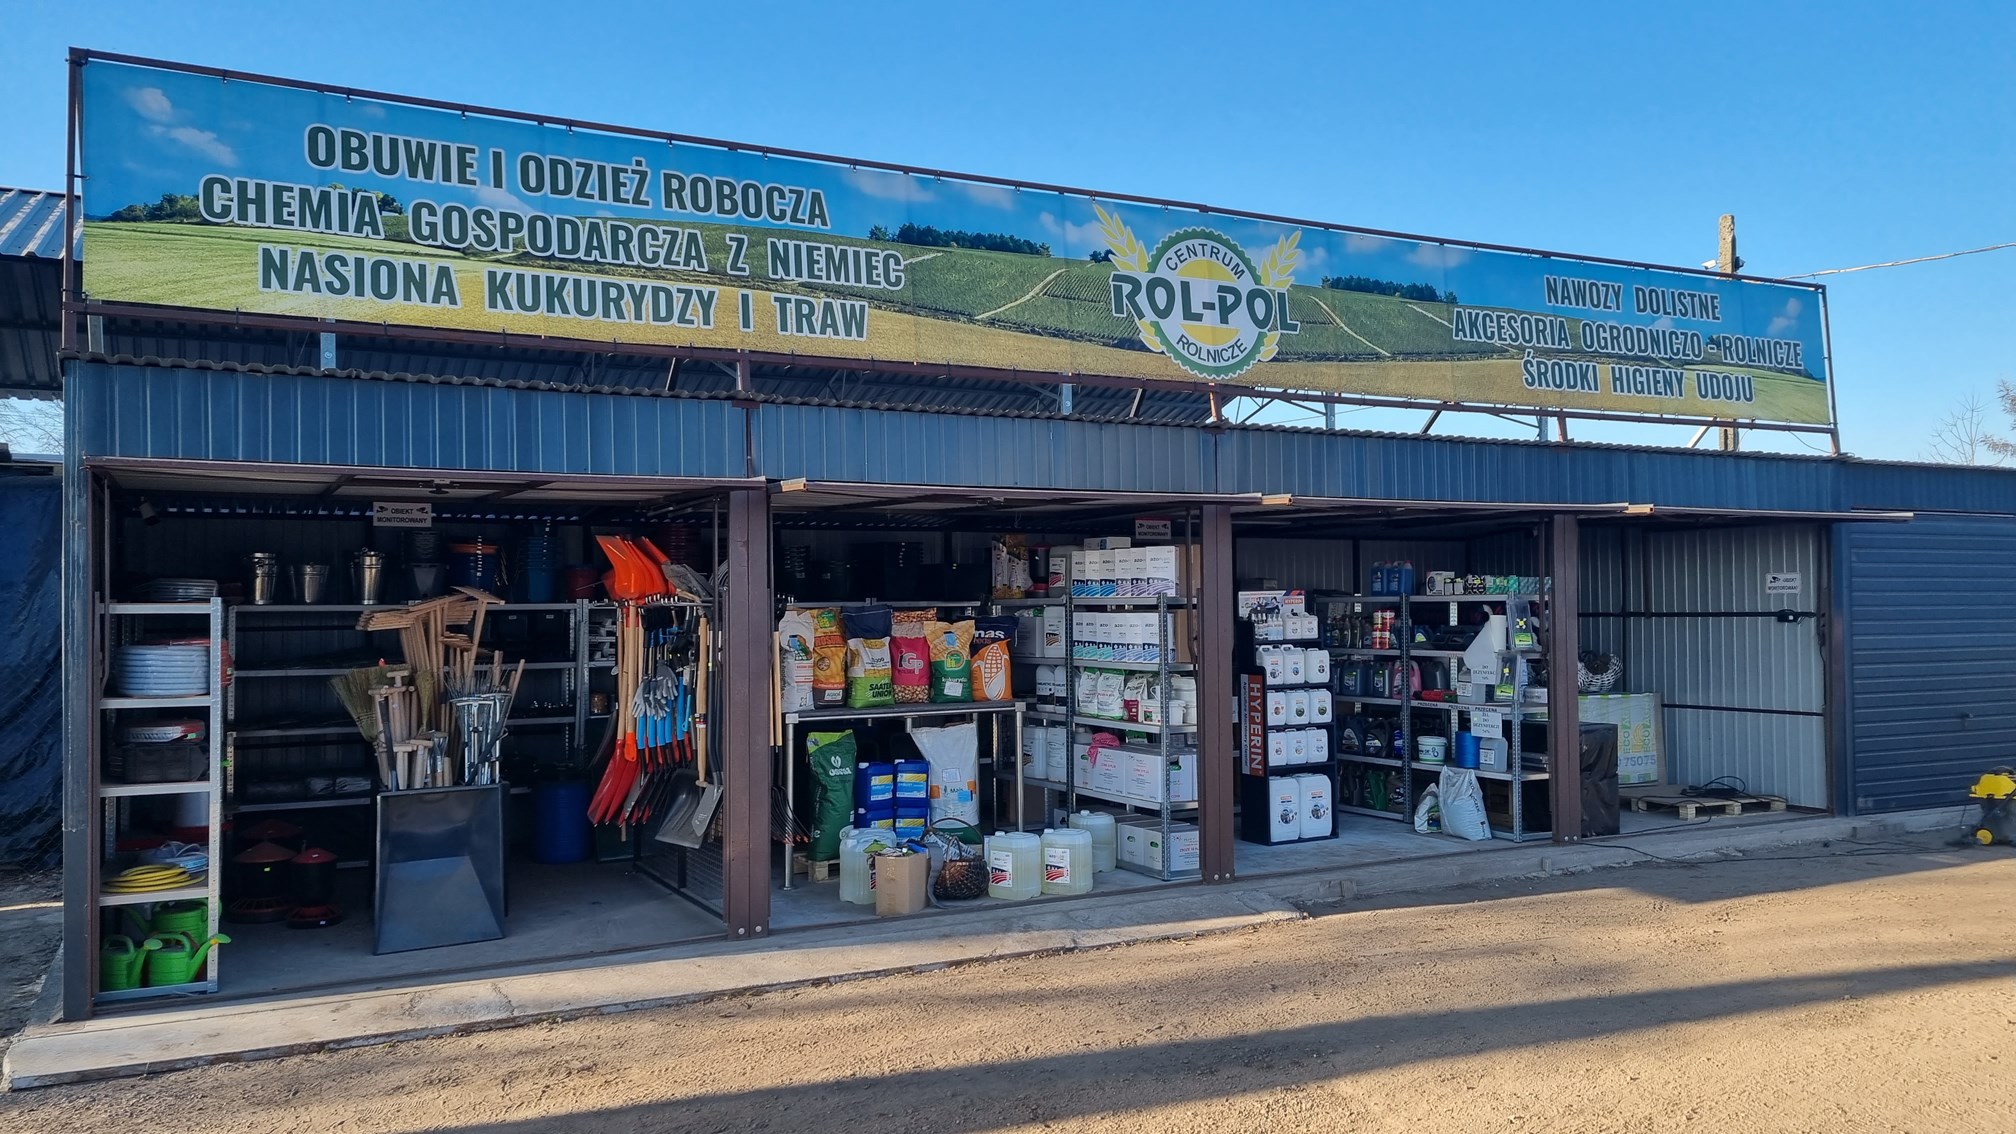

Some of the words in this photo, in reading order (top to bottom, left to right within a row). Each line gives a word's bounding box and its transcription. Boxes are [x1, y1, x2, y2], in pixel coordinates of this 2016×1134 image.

[306, 125, 478, 187] OBUWIE
[491, 149, 504, 190] I
[519, 153, 651, 207] ODZIEŻ
[662, 171, 830, 228] ROBOCZA
[201, 176, 383, 238] CHEMIA
[410, 200, 707, 270] GOSPODARCZA
[727, 235, 748, 274] Z
[769, 239, 904, 289] NIEMIEC
[1165, 243, 1246, 280] CENTRUM
[261, 246, 459, 307] NASIONA
[486, 269, 717, 327] KUKURYDZY
[739, 292, 752, 330] I
[772, 295, 867, 340] TRAW
[1111, 273, 1300, 334] ROL-POL
[1544, 276, 1623, 312] NAWOZY
[1633, 286, 1721, 322] DOLISTNE
[1176, 333, 1248, 364] ROLNICZE
[1453, 309, 1571, 349] AKCESORIA
[1580, 321, 1704, 360] OGRODNICZO
[1720, 334, 1803, 369] ROLNICZE
[1521, 350, 1600, 393] ŚRODKI
[1609, 365, 1685, 399] HIGIENY
[1694, 371, 1756, 404] UDOJU
[376, 516, 428, 524] MONITOROWANY
[390, 507, 414, 515] OBIEKT
[1249, 682, 1262, 770] HYPERIN
